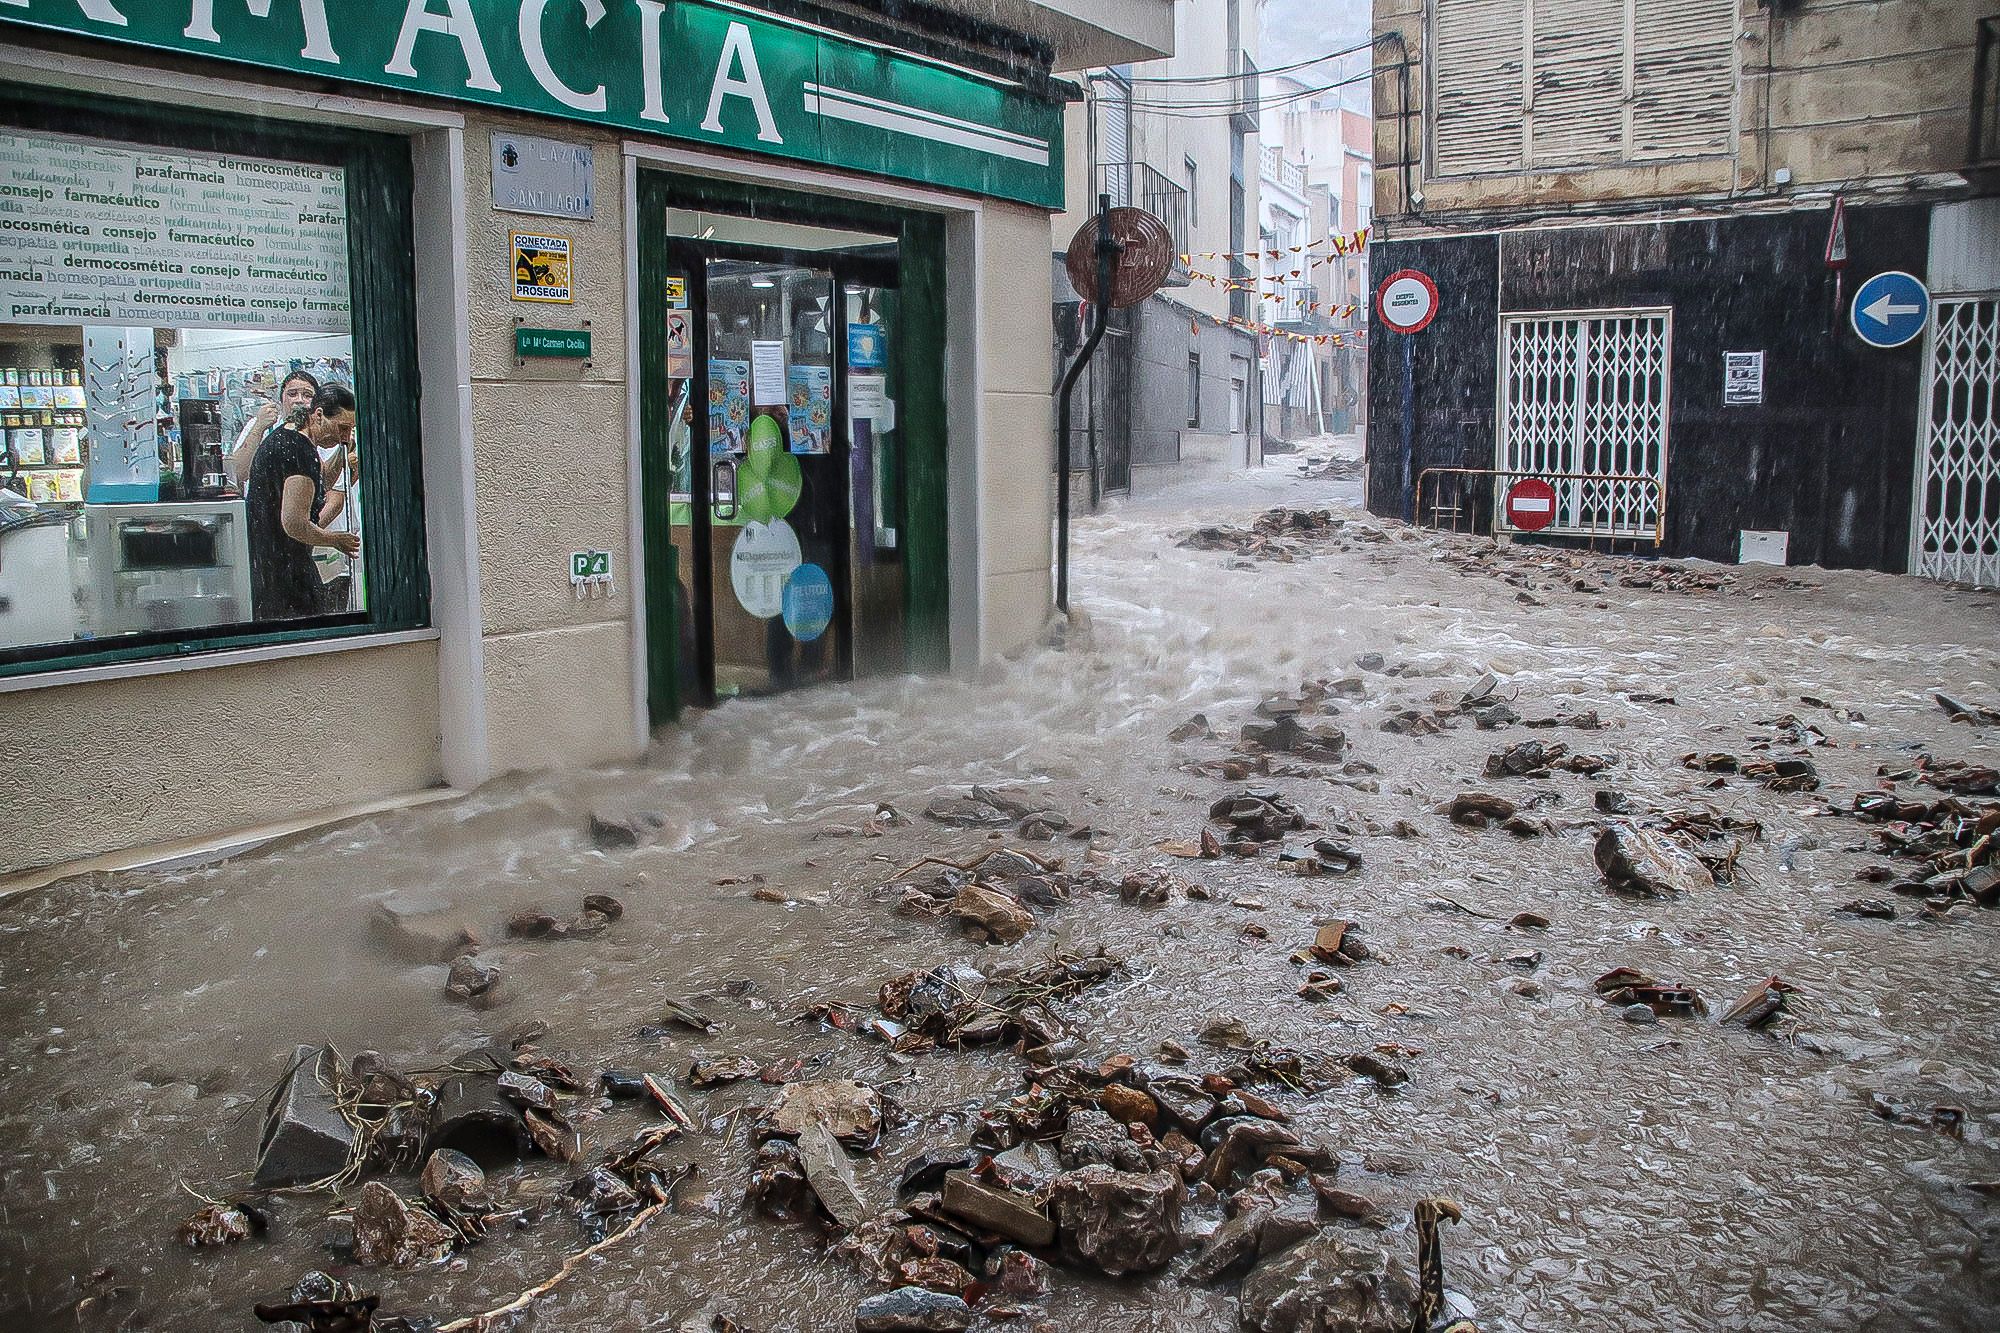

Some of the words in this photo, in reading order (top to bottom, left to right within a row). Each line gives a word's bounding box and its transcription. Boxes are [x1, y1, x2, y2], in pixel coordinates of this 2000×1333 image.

[135, 165, 225, 184] parafarmacia
[218, 156, 323, 180] dermocosmética
[64, 187, 160, 209] farmacéutico
[508, 186, 582, 213] SANTIAGO
[0, 219, 90, 236] ocosmética
[102, 227, 157, 242] consejo
[168, 229, 255, 248] farmacéutico
[515, 235, 568, 248] CONECTADA
[63, 239, 129, 255] ortopedia
[64, 254, 183, 274] dermocosmética
[190, 264, 241, 279] consejo
[247, 265, 328, 281] farmacéutico
[139, 277, 201, 291] ortopedia
[516, 285, 569, 298] PROSEGUR
[133, 290, 246, 308] dermocosmética
[250, 297, 298, 312] consejo
[11, 302, 111, 317] parafarmacia
[207, 310, 265, 324] ortopedia
[542, 337, 565, 349] Carmen
[566, 338, 585, 349] Cecilia
[740, 380, 748, 396] 3
[822, 385, 830, 399] 3
[577, 557, 588, 573] P
